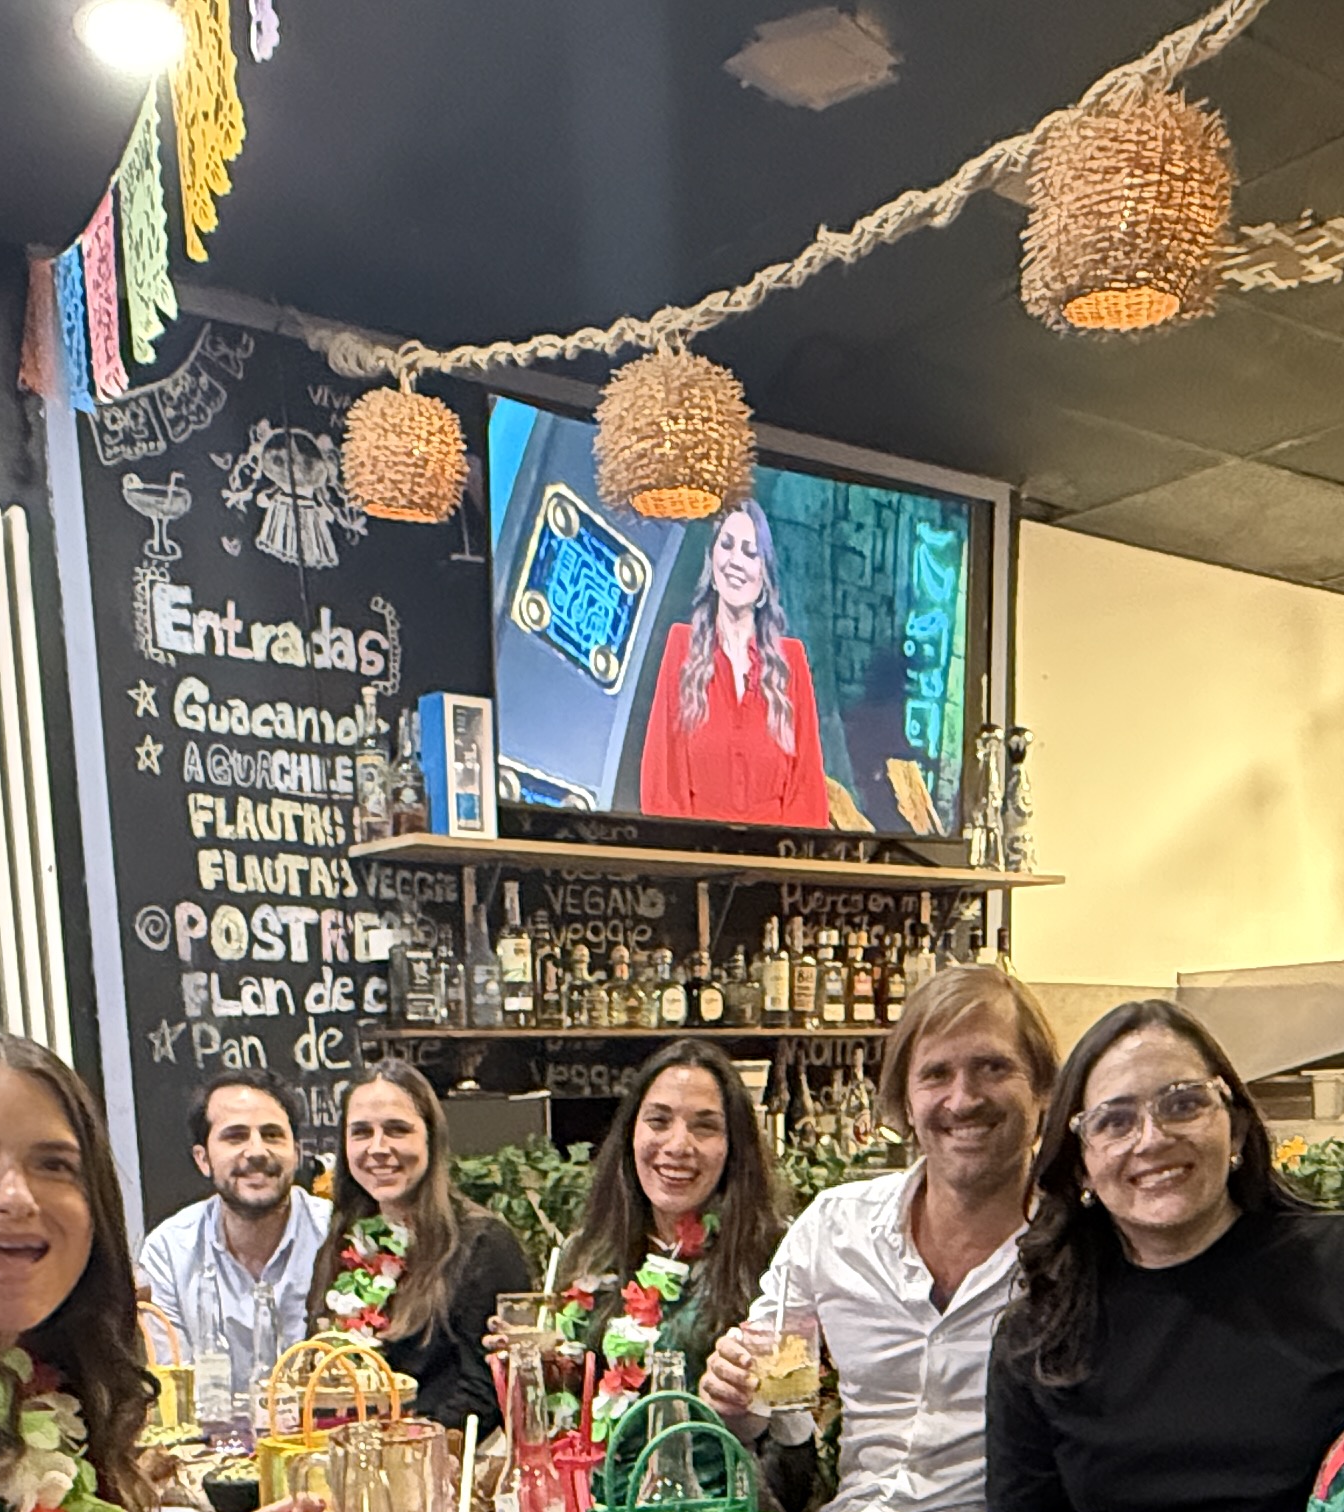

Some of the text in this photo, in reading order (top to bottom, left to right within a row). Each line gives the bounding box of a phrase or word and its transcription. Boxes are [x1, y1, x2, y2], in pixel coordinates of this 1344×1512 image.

[151, 583, 390, 676] Entradas
[187, 792, 346, 847] FLAUTAS
[174, 900, 400, 963] POSTRE
[304, 964, 355, 1014] de
[191, 1020, 268, 1070] Pan
[293, 1015, 352, 1071] de
